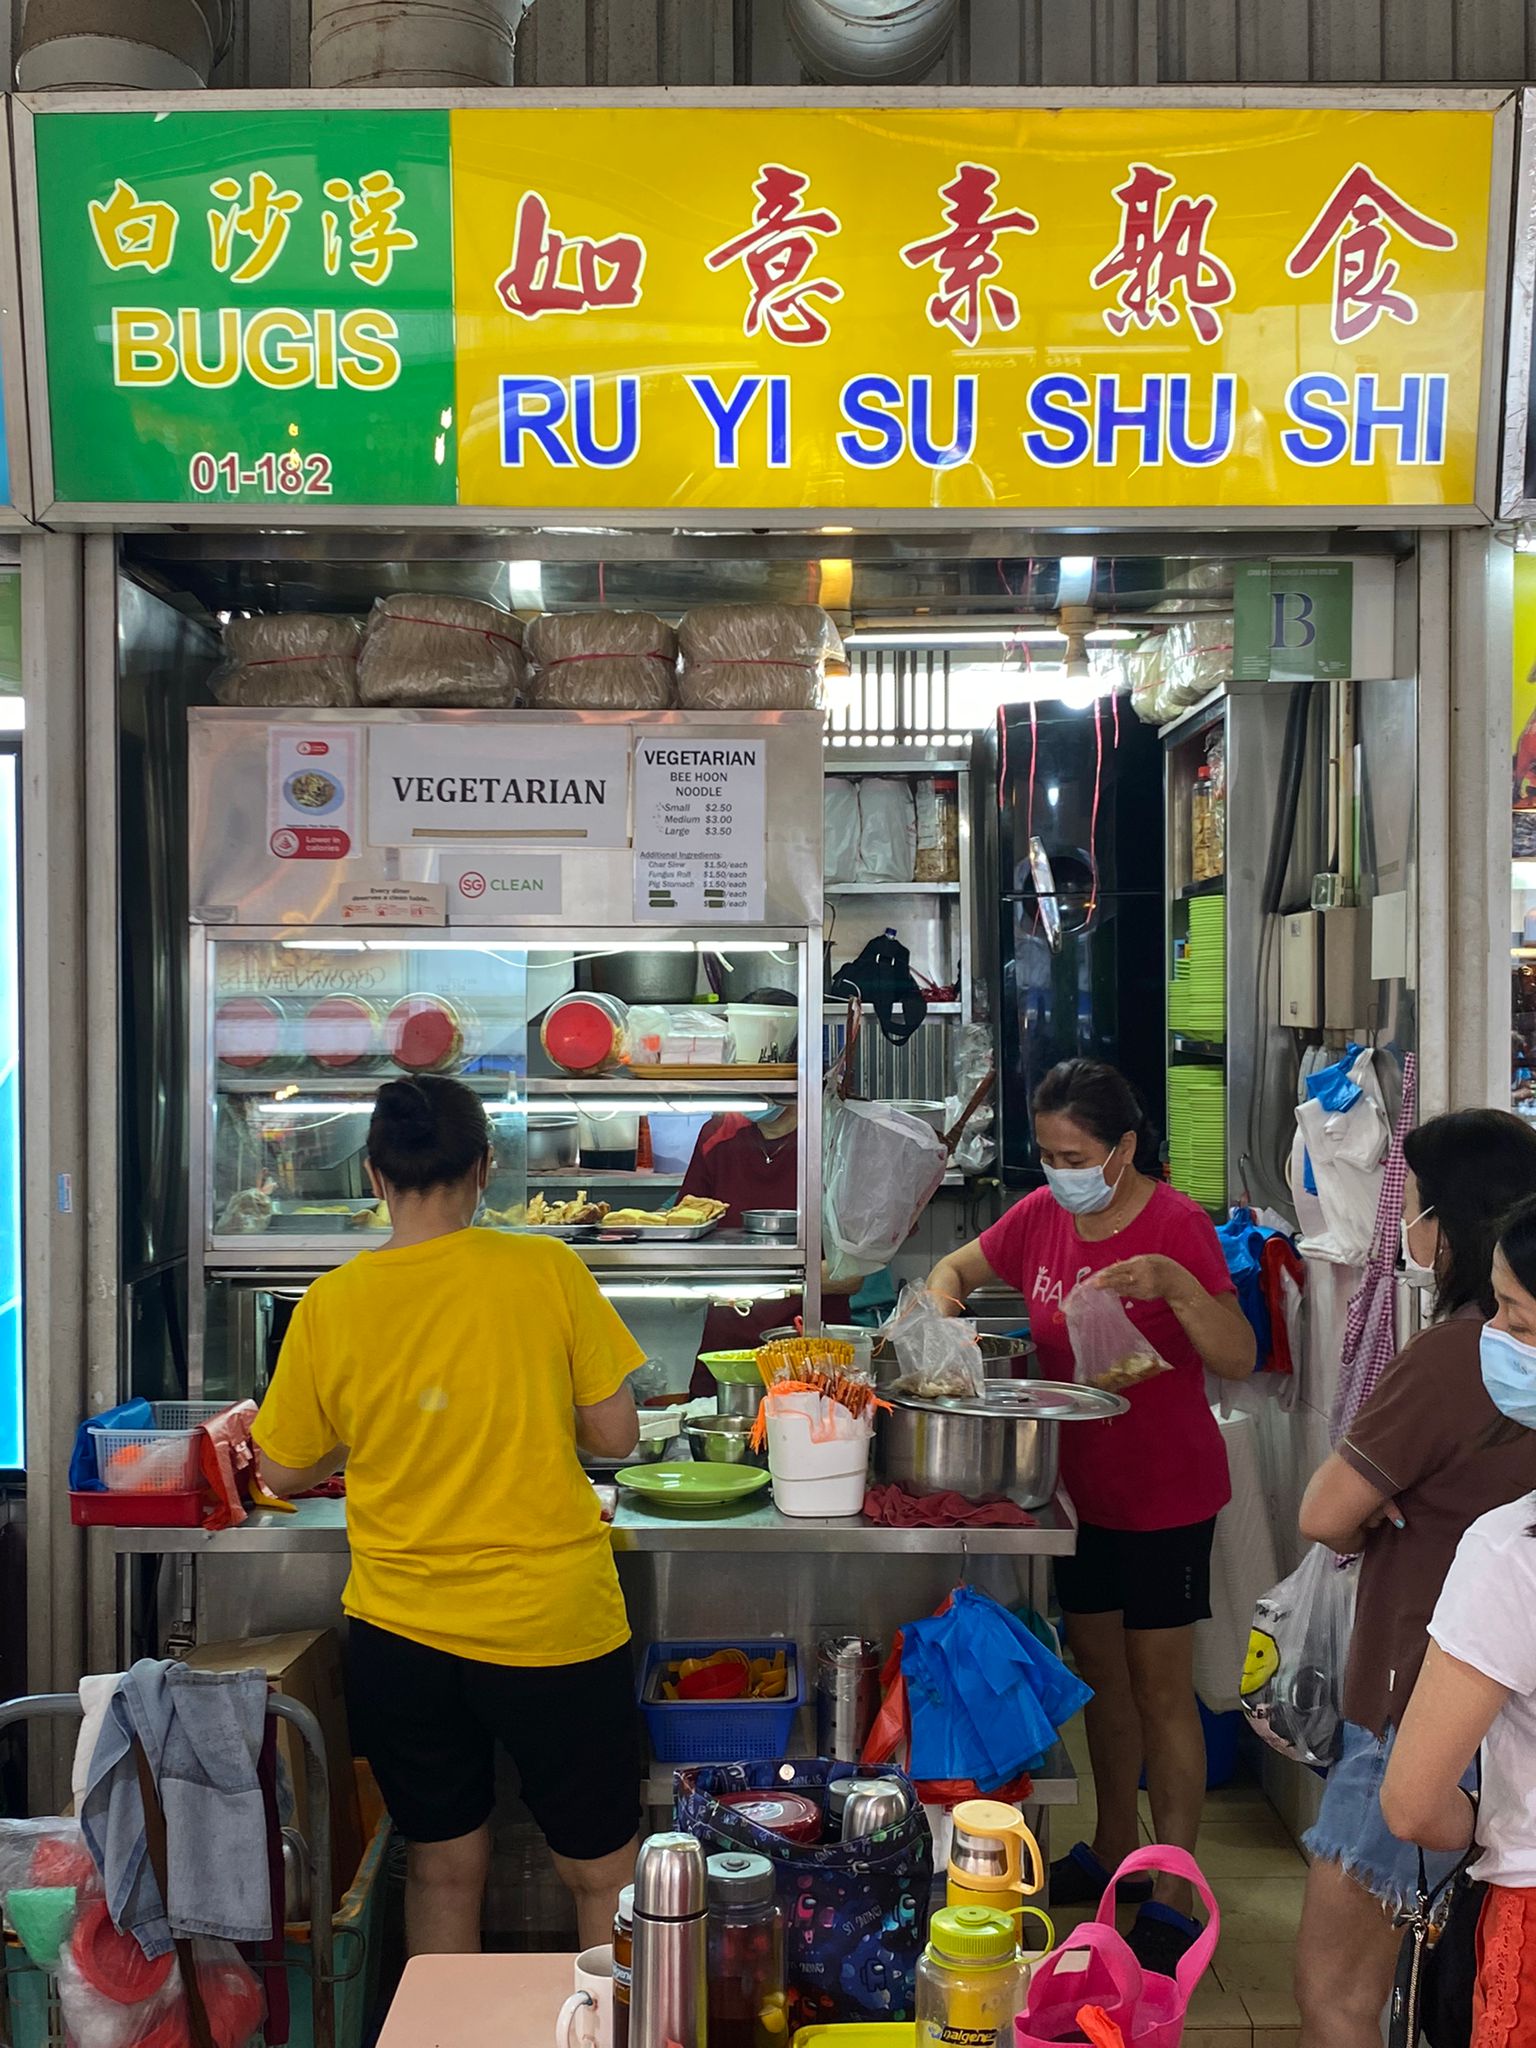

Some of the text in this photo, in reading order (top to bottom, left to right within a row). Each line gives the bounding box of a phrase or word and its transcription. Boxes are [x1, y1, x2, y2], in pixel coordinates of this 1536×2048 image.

[87, 170, 418, 286] 白沙浮
[495, 161, 1458, 347] 如意素熟食
[111, 306, 402, 391] BUGIS
[498, 373, 1447, 469] RU YI SU SHU SHI
[188, 452, 333, 495] 01-182
[1267, 592, 1316, 650] B
[644, 750, 756, 766] VEGETARIAN
[670, 772, 728, 782] BEE HOON
[392, 776, 606, 805] VEGETARIAN
[676, 787, 722, 797] NOODLE
[665, 803, 732, 812] Small $2.50
[664, 815, 732, 824] Medium $3.00
[664, 827, 732, 837] Large $3.50
[640, 851, 678, 860] Additional
[704, 861, 748, 869] $1.50/each
[463, 879, 544, 891] SG CLEAN
[943, 2029, 992, 2045] nalgene
